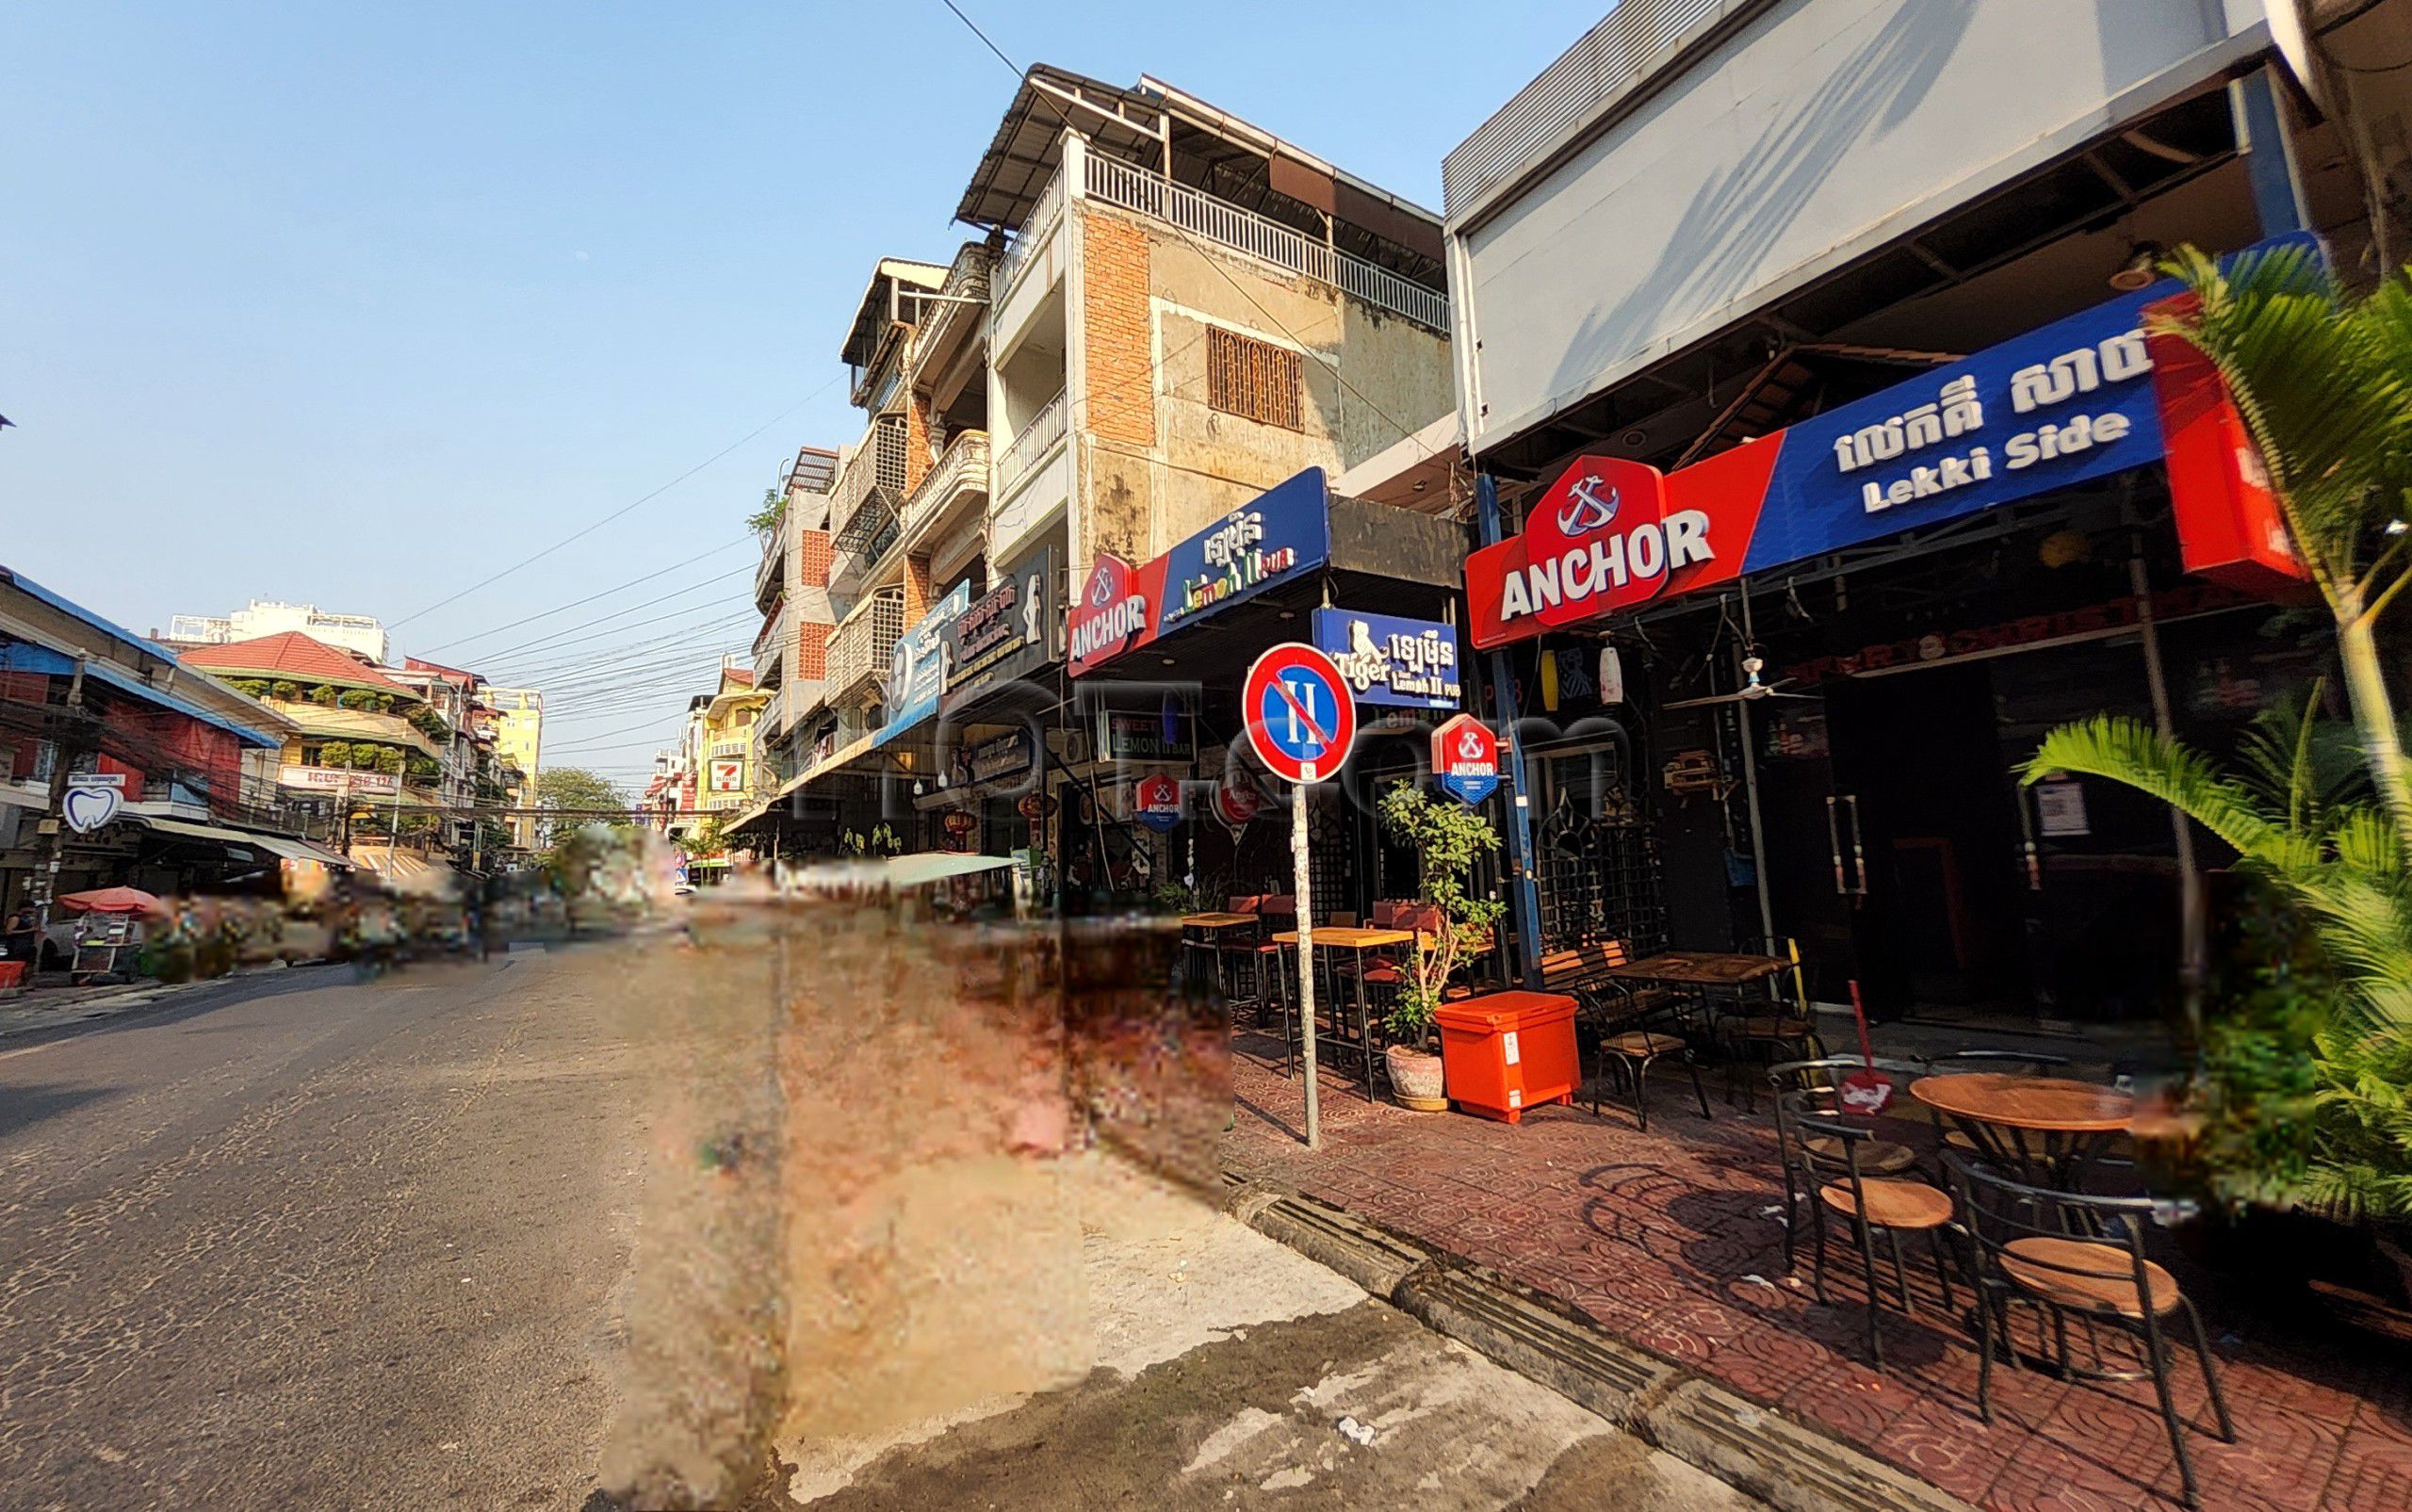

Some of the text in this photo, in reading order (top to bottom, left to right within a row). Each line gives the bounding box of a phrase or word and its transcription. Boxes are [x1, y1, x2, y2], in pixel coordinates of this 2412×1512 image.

[1863, 413, 2131, 513] Lekki Side
[1501, 510, 1715, 621] ANCHOR
[1069, 594, 1146, 661] ANCHOR
[1333, 652, 1391, 691] Tiger
[1444, 683, 1461, 697] PUB
[1111, 717, 1157, 731] SWEET
[1112, 733, 1160, 754] LEMON
[1173, 742, 1191, 755] BAR
[1451, 762, 1494, 776] ANCHOR
[1148, 804, 1180, 814] ANCHOR
